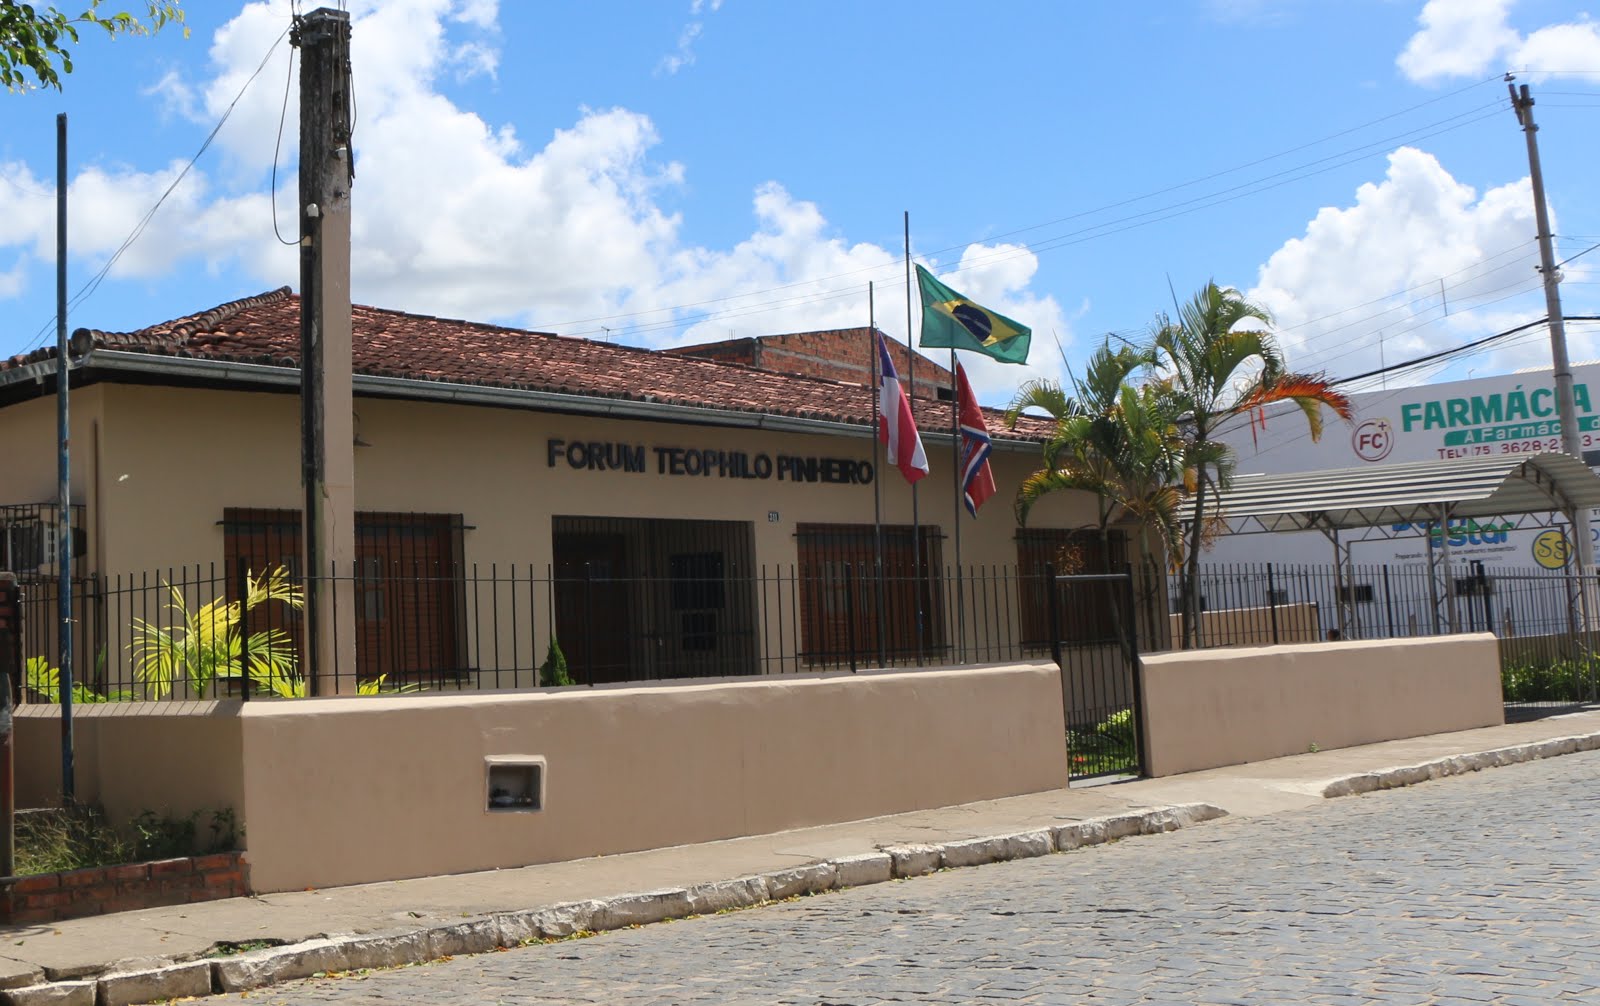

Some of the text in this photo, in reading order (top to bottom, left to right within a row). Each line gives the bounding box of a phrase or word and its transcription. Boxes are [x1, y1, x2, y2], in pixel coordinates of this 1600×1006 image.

[1401, 383, 1592, 432] FARMÁCIA
[1464, 429, 1475, 444] A
[1481, 421, 1563, 442] Farmác
[547, 439, 874, 485] FORUM TEOPHILO PINHEIRO
